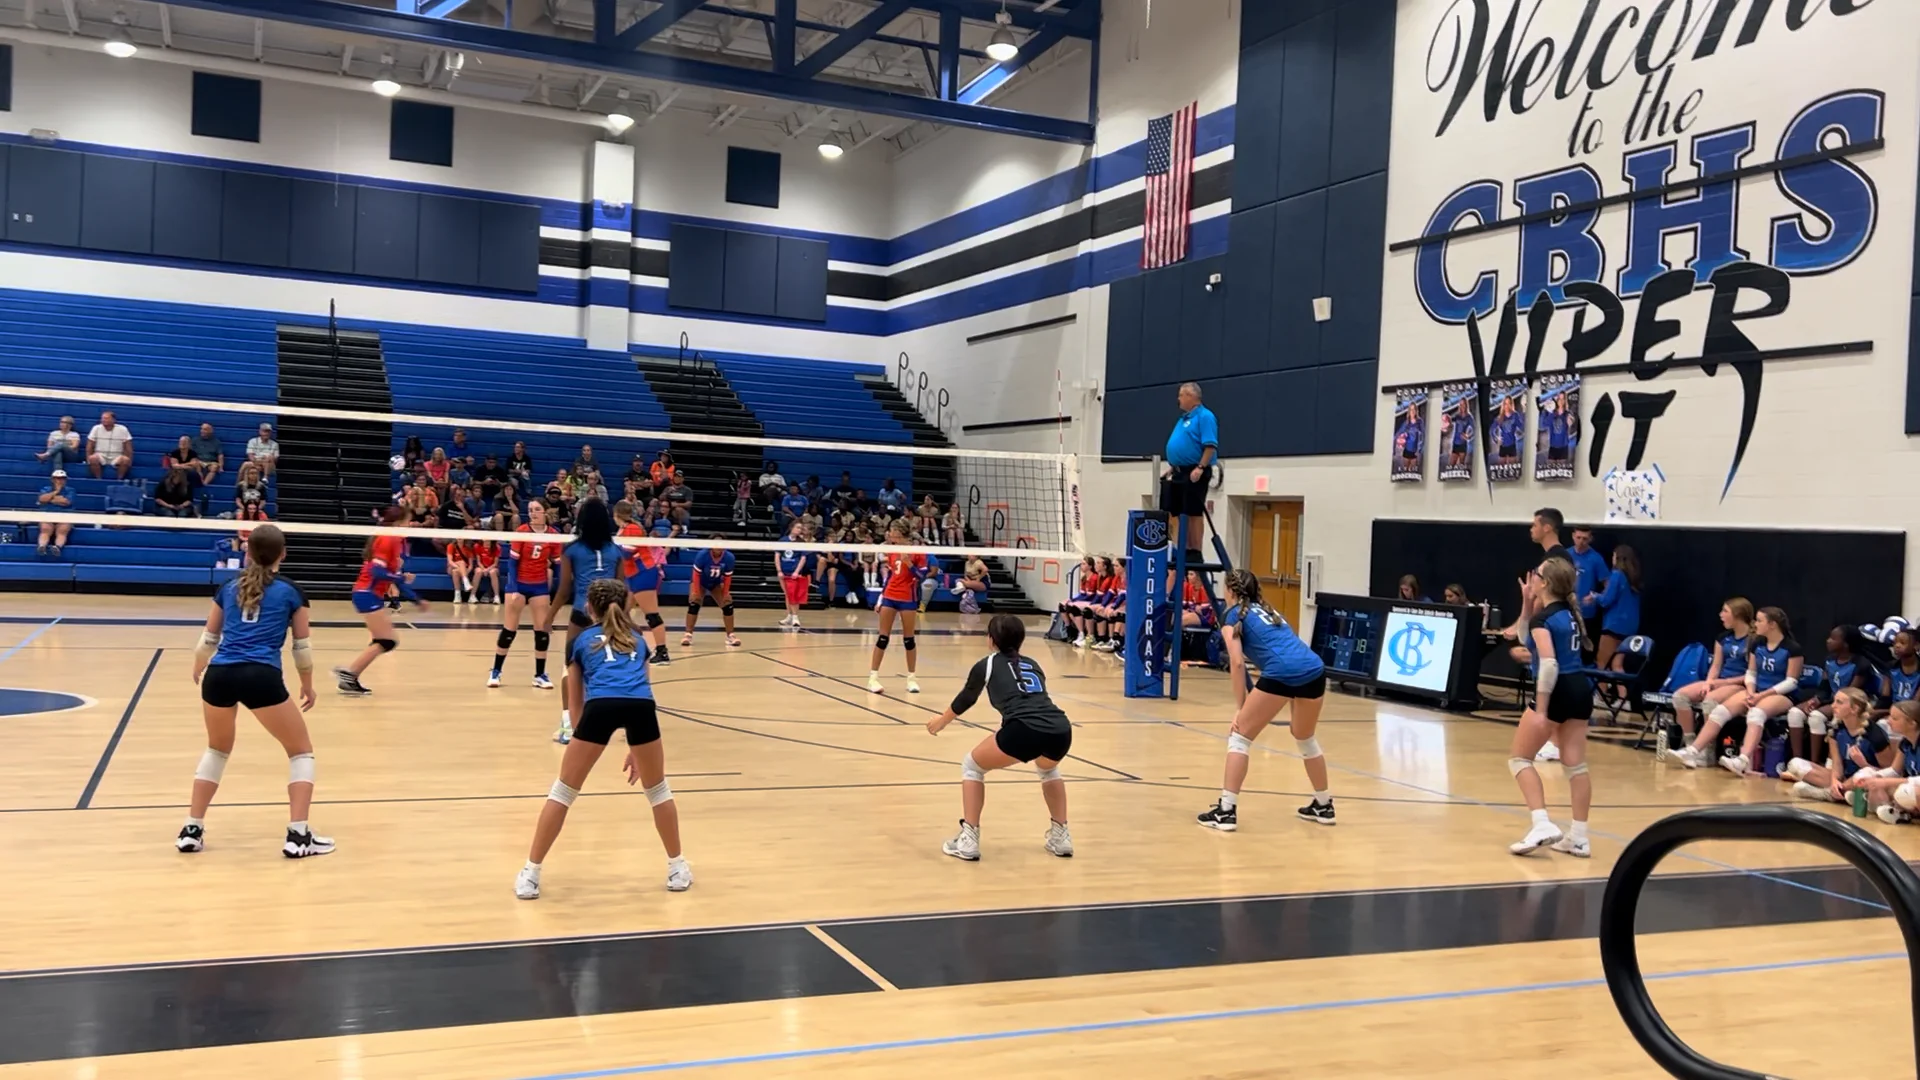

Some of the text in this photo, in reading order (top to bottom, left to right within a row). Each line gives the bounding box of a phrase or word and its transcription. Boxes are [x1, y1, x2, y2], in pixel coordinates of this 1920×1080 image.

[1426, 0, 1878, 138] Welcom
[1567, 64, 1704, 158] to the
[1413, 88, 1886, 326] CBHS
[1466, 260, 1791, 505] VIPER
[1536, 468, 1573, 479] HEDGES
[1588, 390, 1677, 478] IT
[531, 545, 543, 559] 6
[595, 550, 605, 571] 1
[894, 560, 902, 575] 3
[1145, 557, 1155, 677] COBRAS
